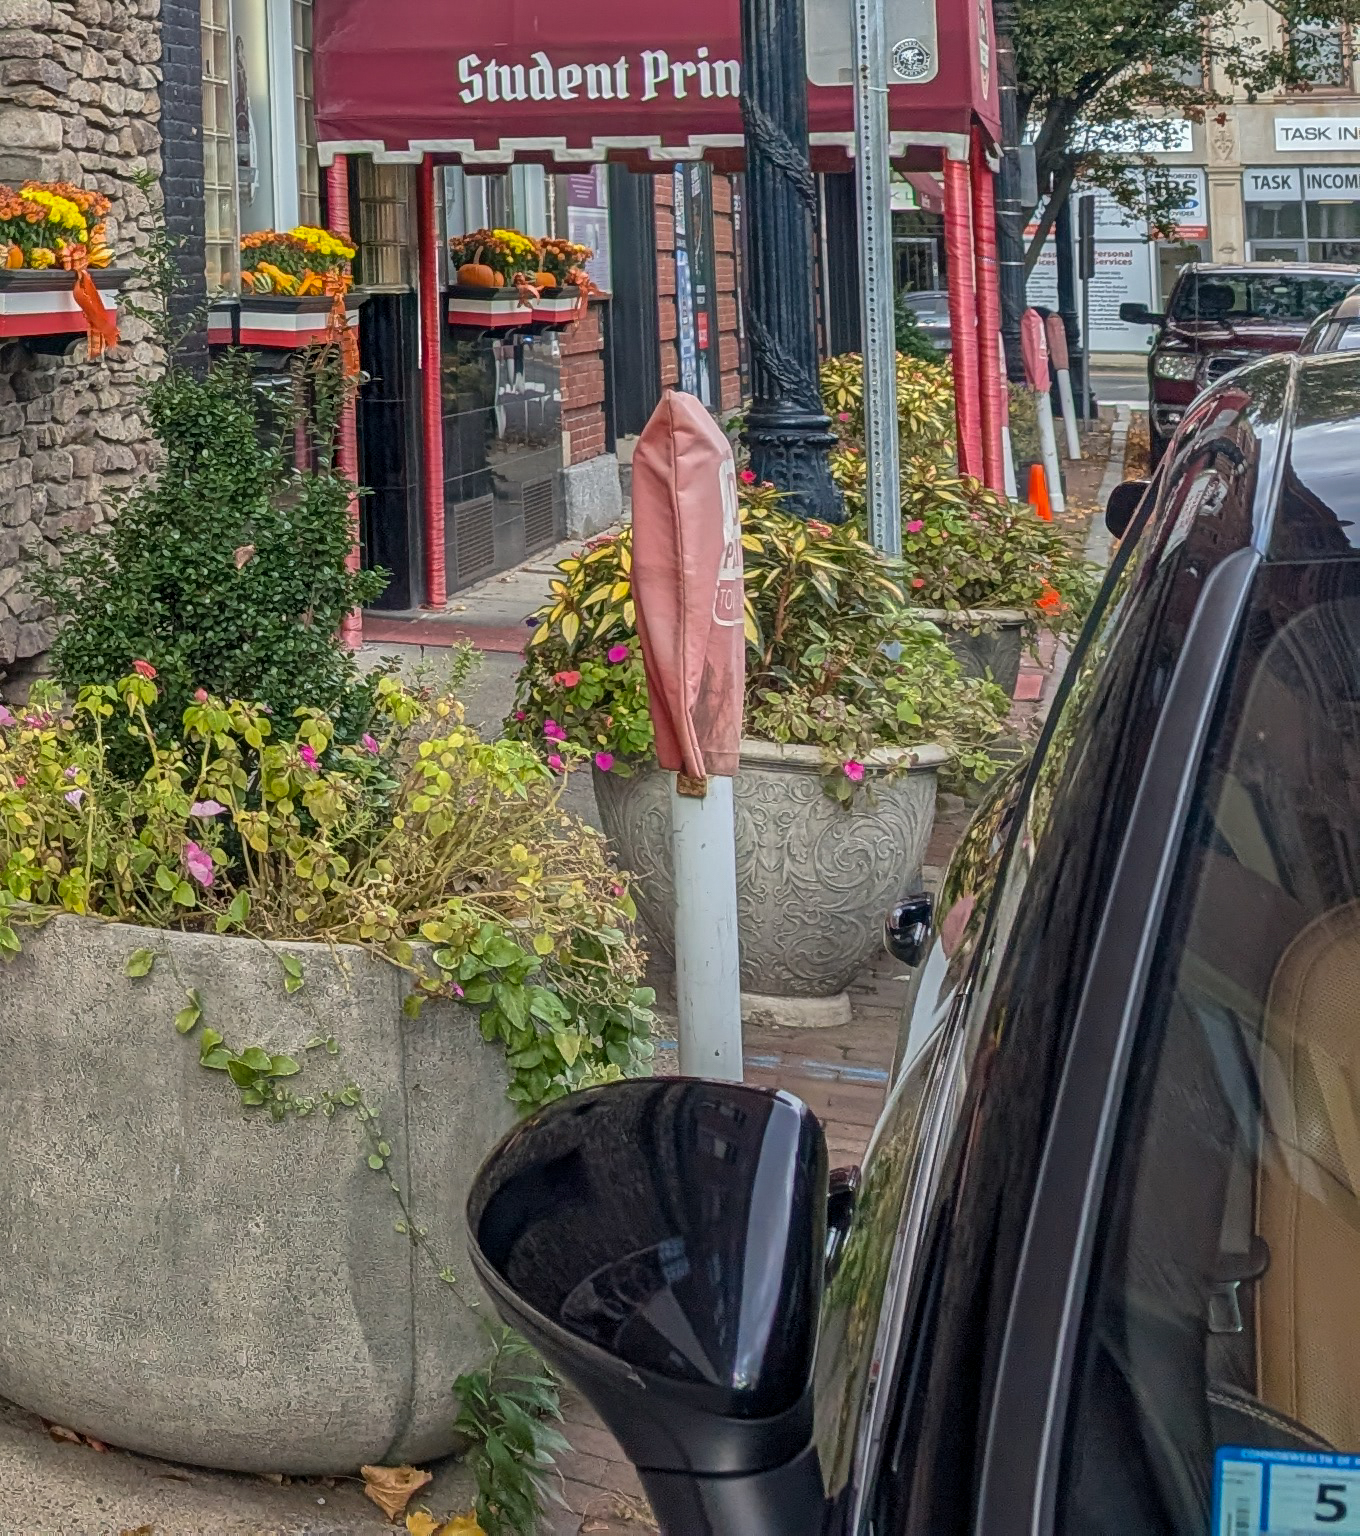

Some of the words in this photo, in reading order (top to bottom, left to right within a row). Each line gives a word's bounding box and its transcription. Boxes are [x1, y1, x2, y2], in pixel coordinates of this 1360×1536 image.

[458, 51, 630, 104] Student
[640, 46, 741, 102] Prin
[1281, 127, 1331, 141] TASK
[1338, 127, 1360, 141] IN
[1251, 175, 1292, 190] TASK
[1307, 173, 1360, 189] INCOM
[1314, 1483, 1347, 1523] 5
